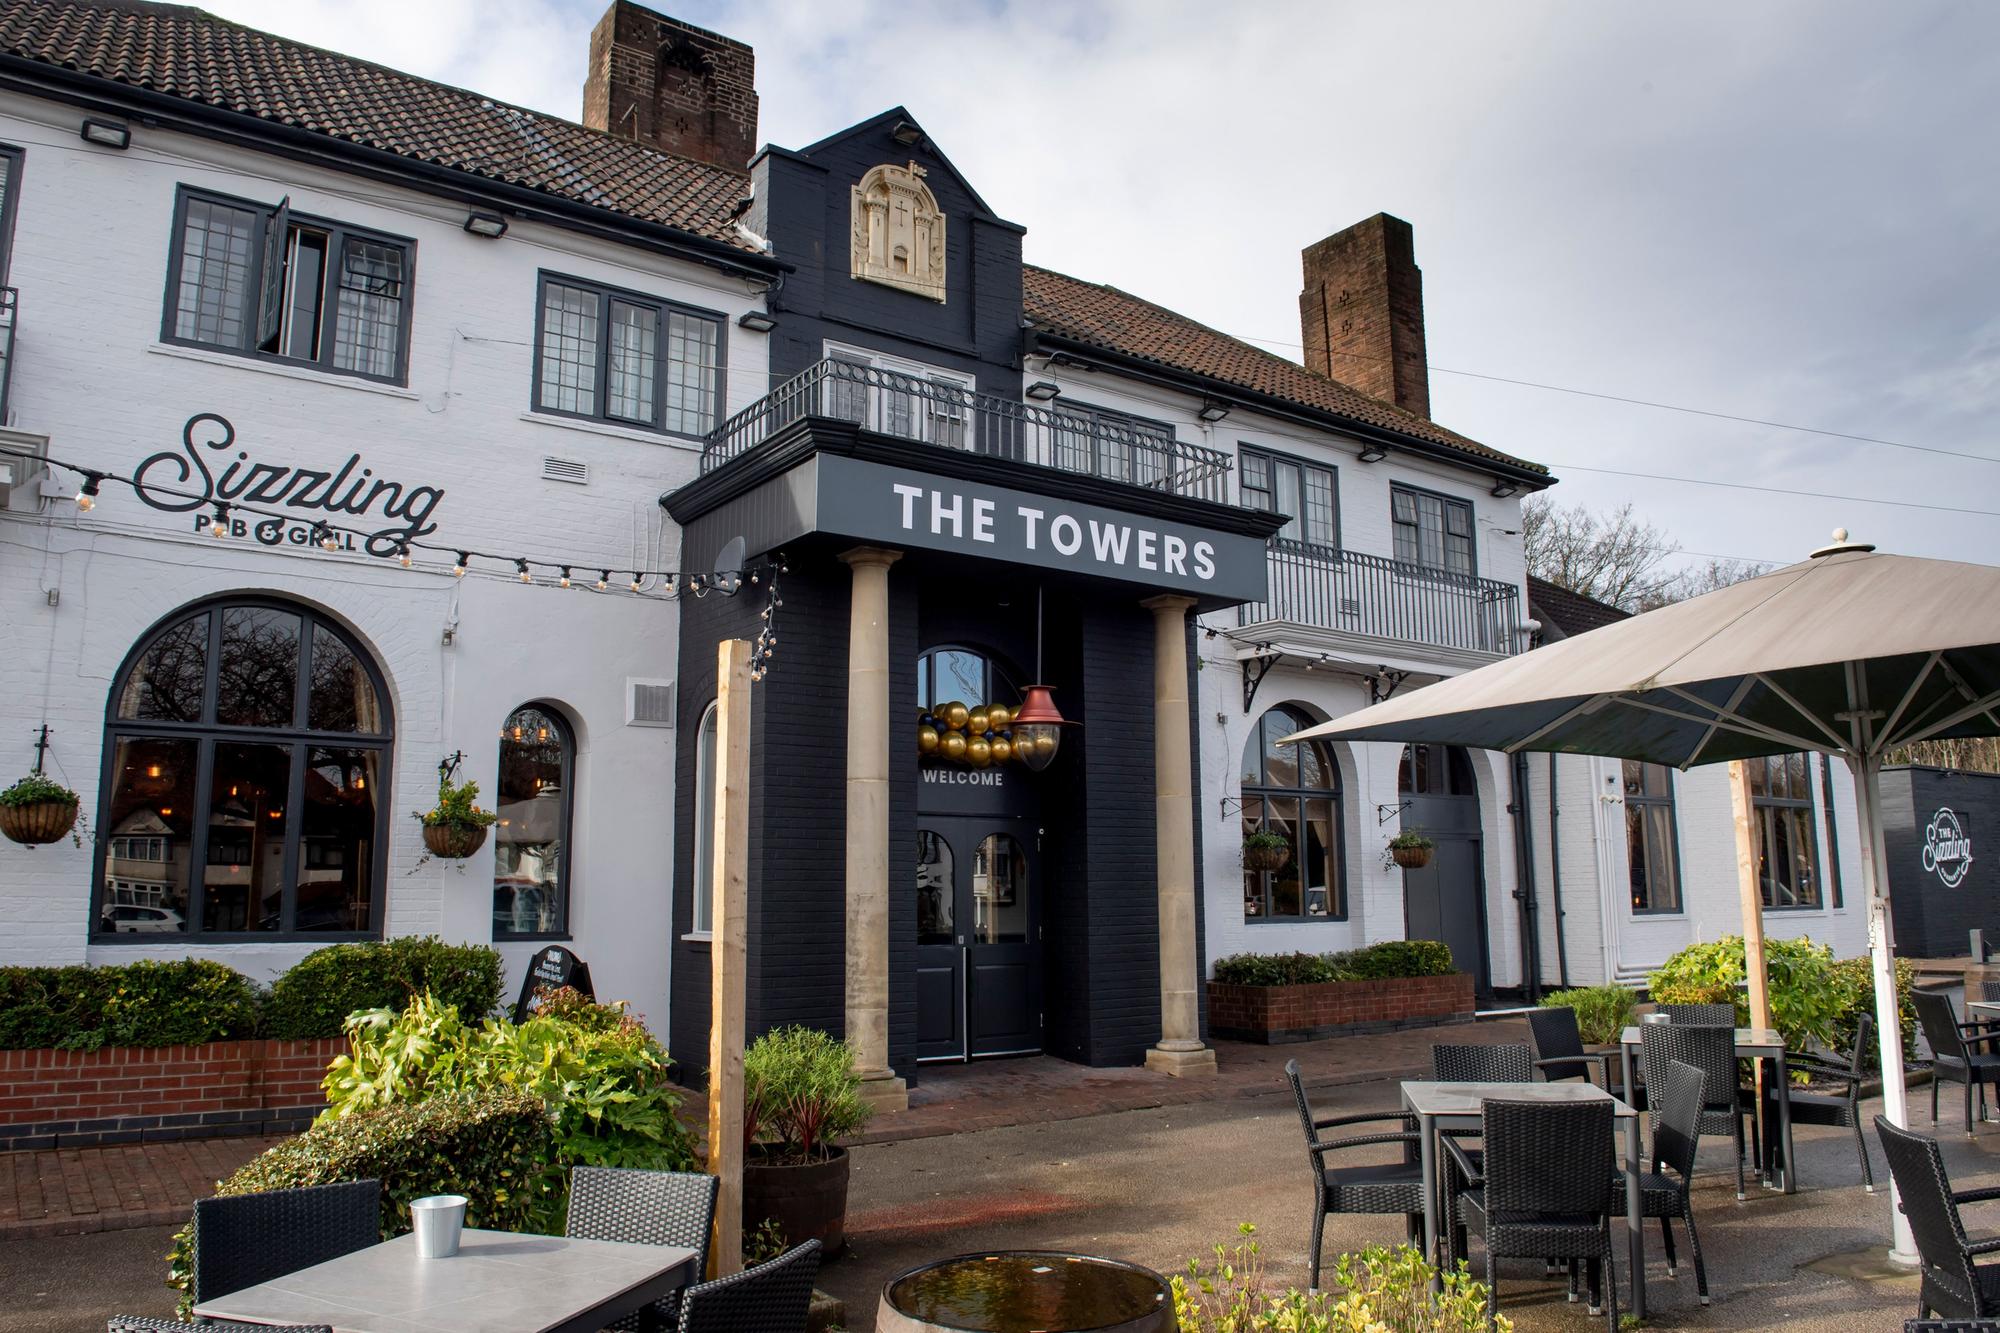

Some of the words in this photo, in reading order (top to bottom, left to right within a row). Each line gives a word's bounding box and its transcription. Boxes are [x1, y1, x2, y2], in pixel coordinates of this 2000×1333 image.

[134, 413, 445, 557] Sizzling
[194, 514, 247, 537] PB
[288, 526, 356, 550] GRLL
[893, 483, 995, 543] THE
[1018, 506, 1216, 580] TOWERS
[922, 769, 1003, 786] WELCOME
[1923, 824, 1972, 875] Sizzling
[1938, 828, 1951, 838] THE
